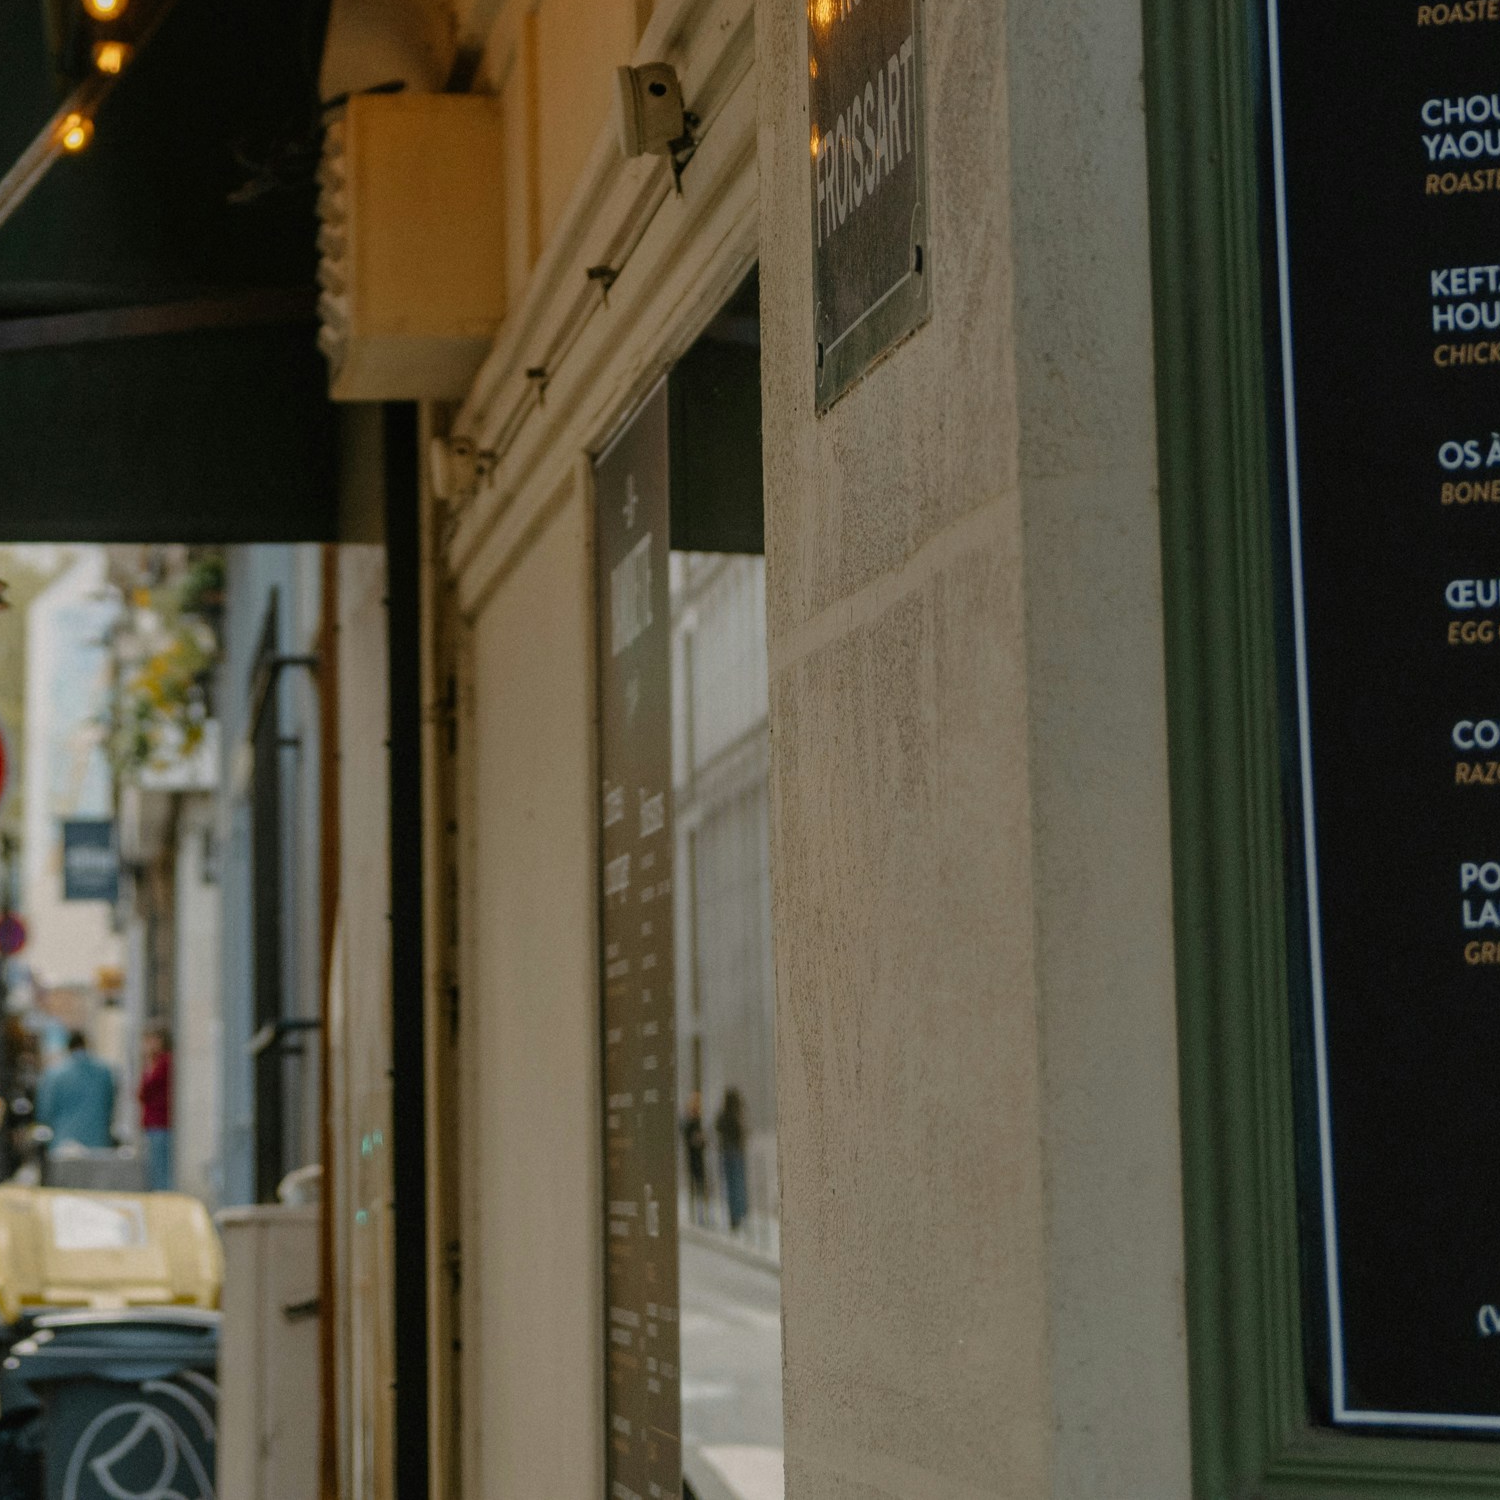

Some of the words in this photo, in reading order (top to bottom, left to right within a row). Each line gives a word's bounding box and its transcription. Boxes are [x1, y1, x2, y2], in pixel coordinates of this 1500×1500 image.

[815, 34, 912, 248] FROISSART
[1438, 439, 1482, 470] OS
[1447, 620, 1495, 645] EGG
